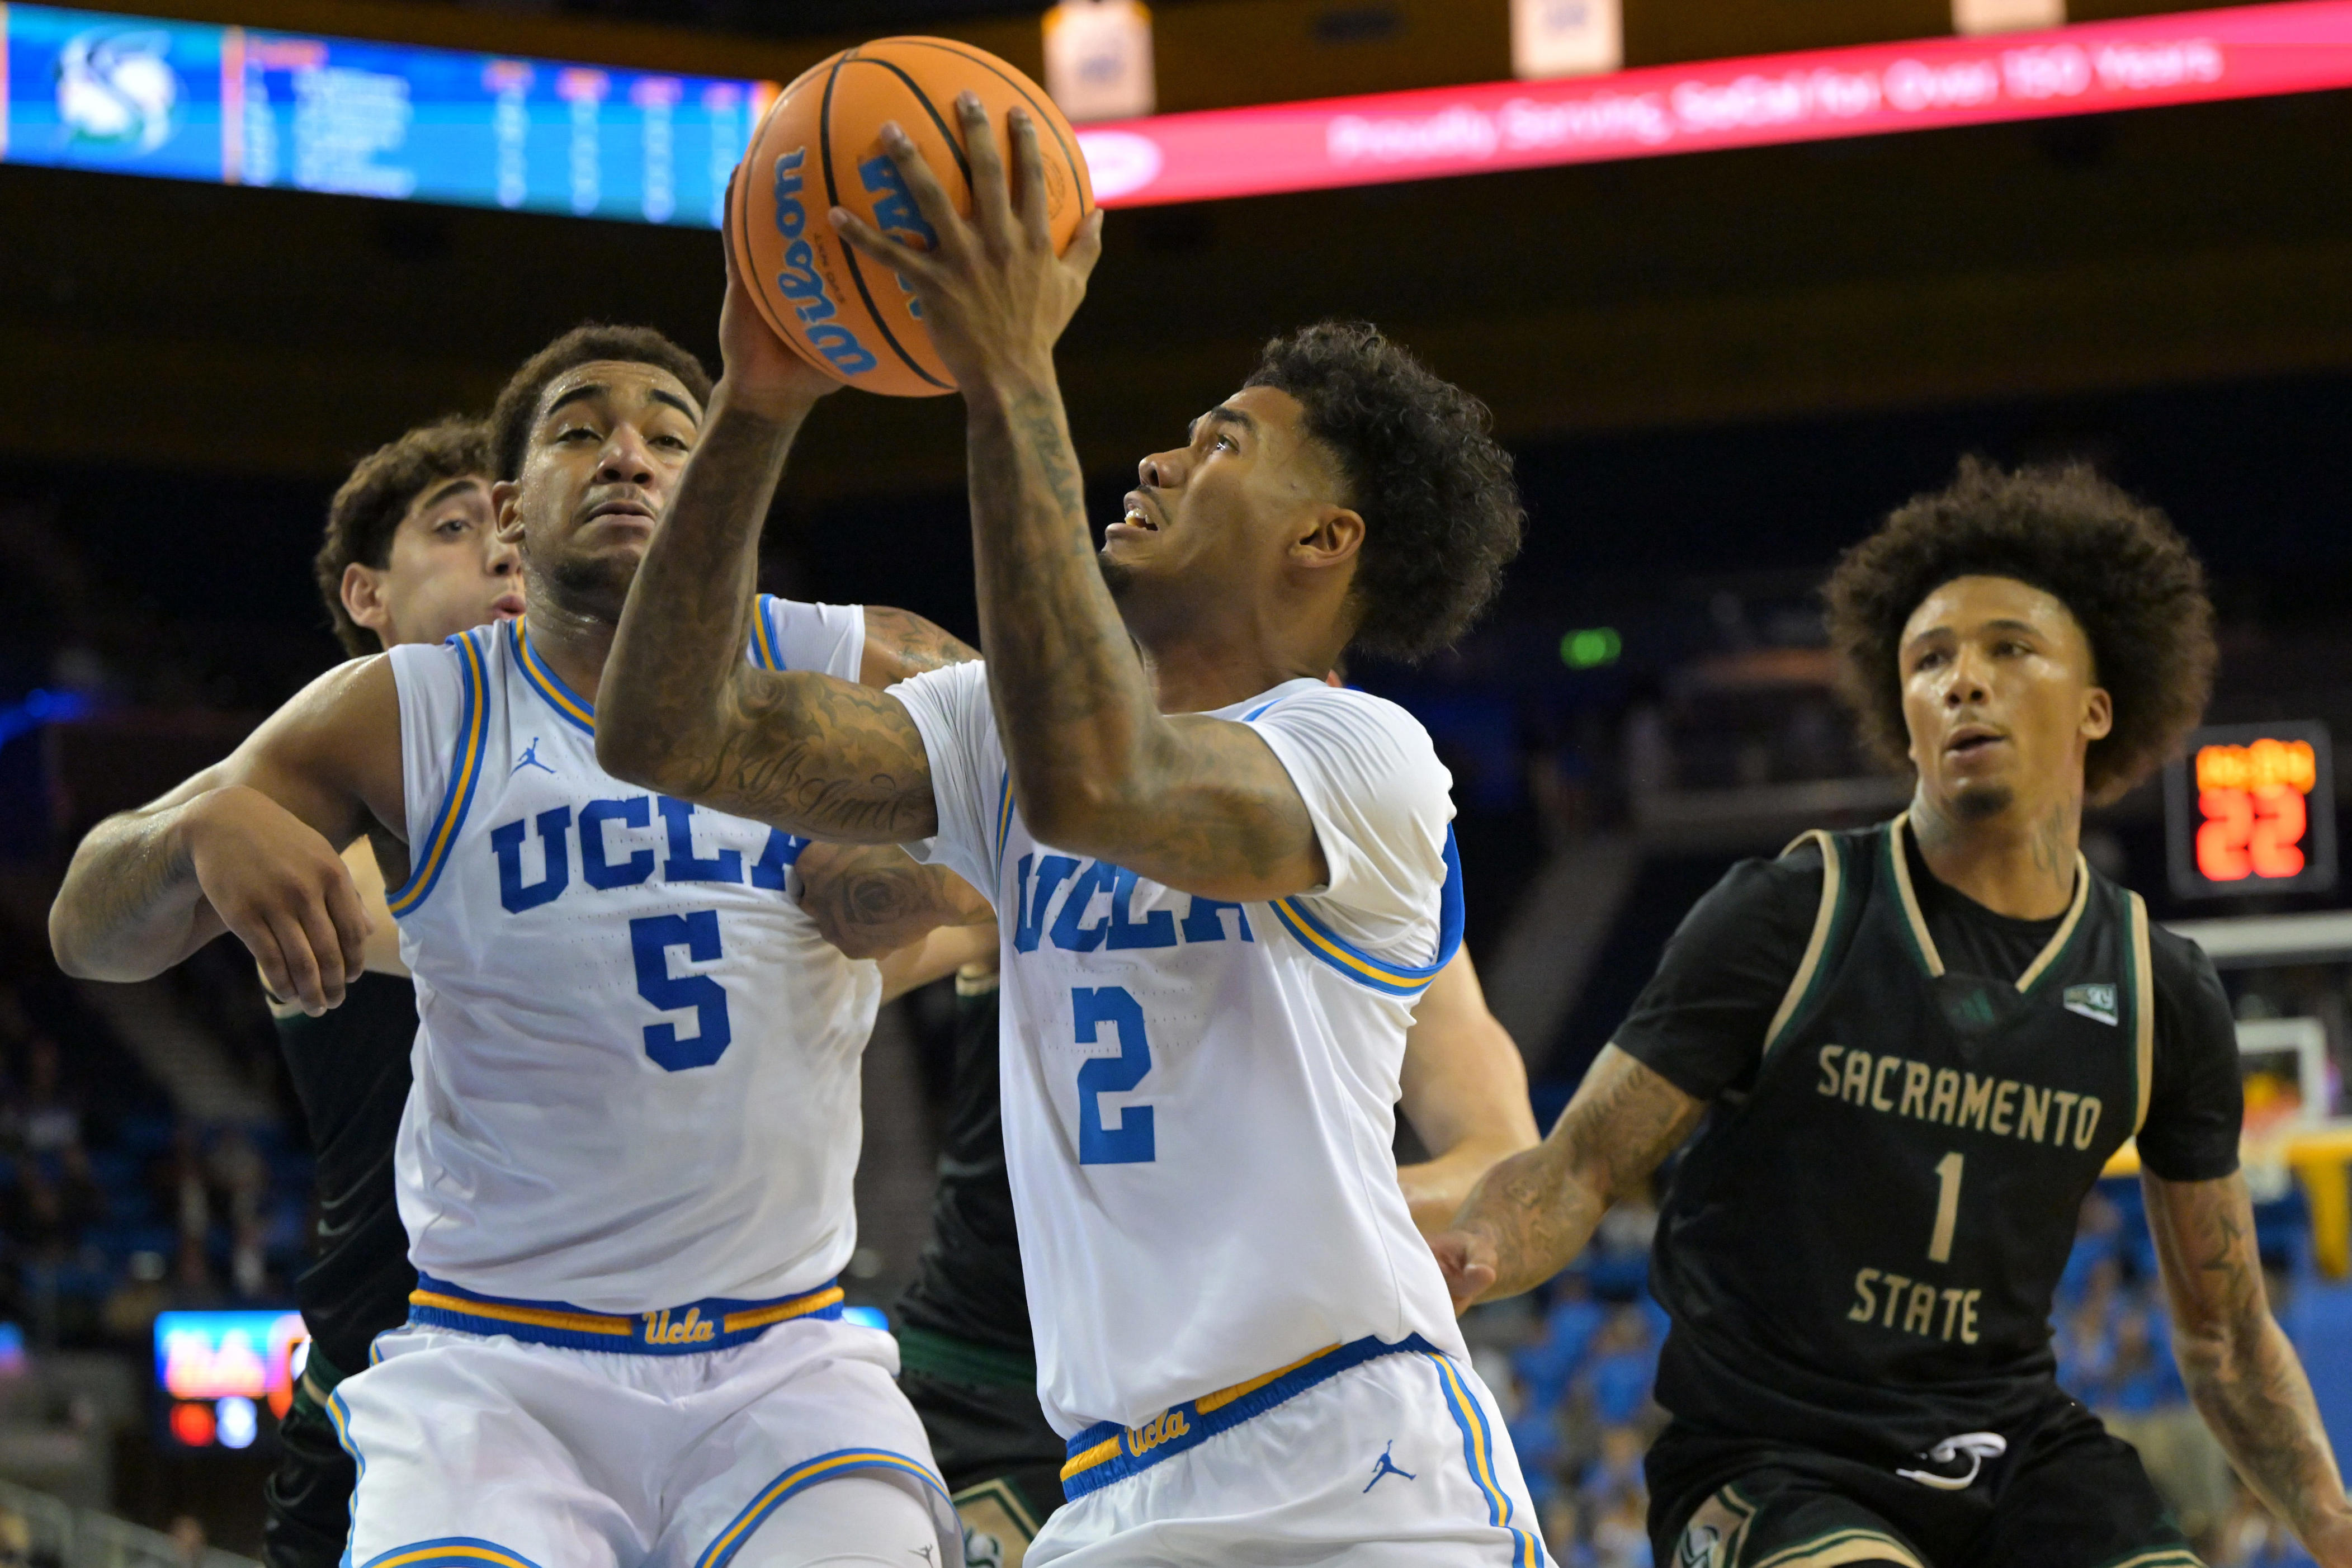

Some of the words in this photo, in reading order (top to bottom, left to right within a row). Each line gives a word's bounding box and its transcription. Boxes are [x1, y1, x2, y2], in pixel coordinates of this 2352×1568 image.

[774, 147, 877, 375] Wilson
[629, 910, 731, 1072] 5
[1071, 986, 1155, 1165] 2
[1817, 1043, 2102, 1151] SACRAMENTO
[1928, 1151, 1964, 1264] 1
[1848, 1267, 1981, 1344] STATE
